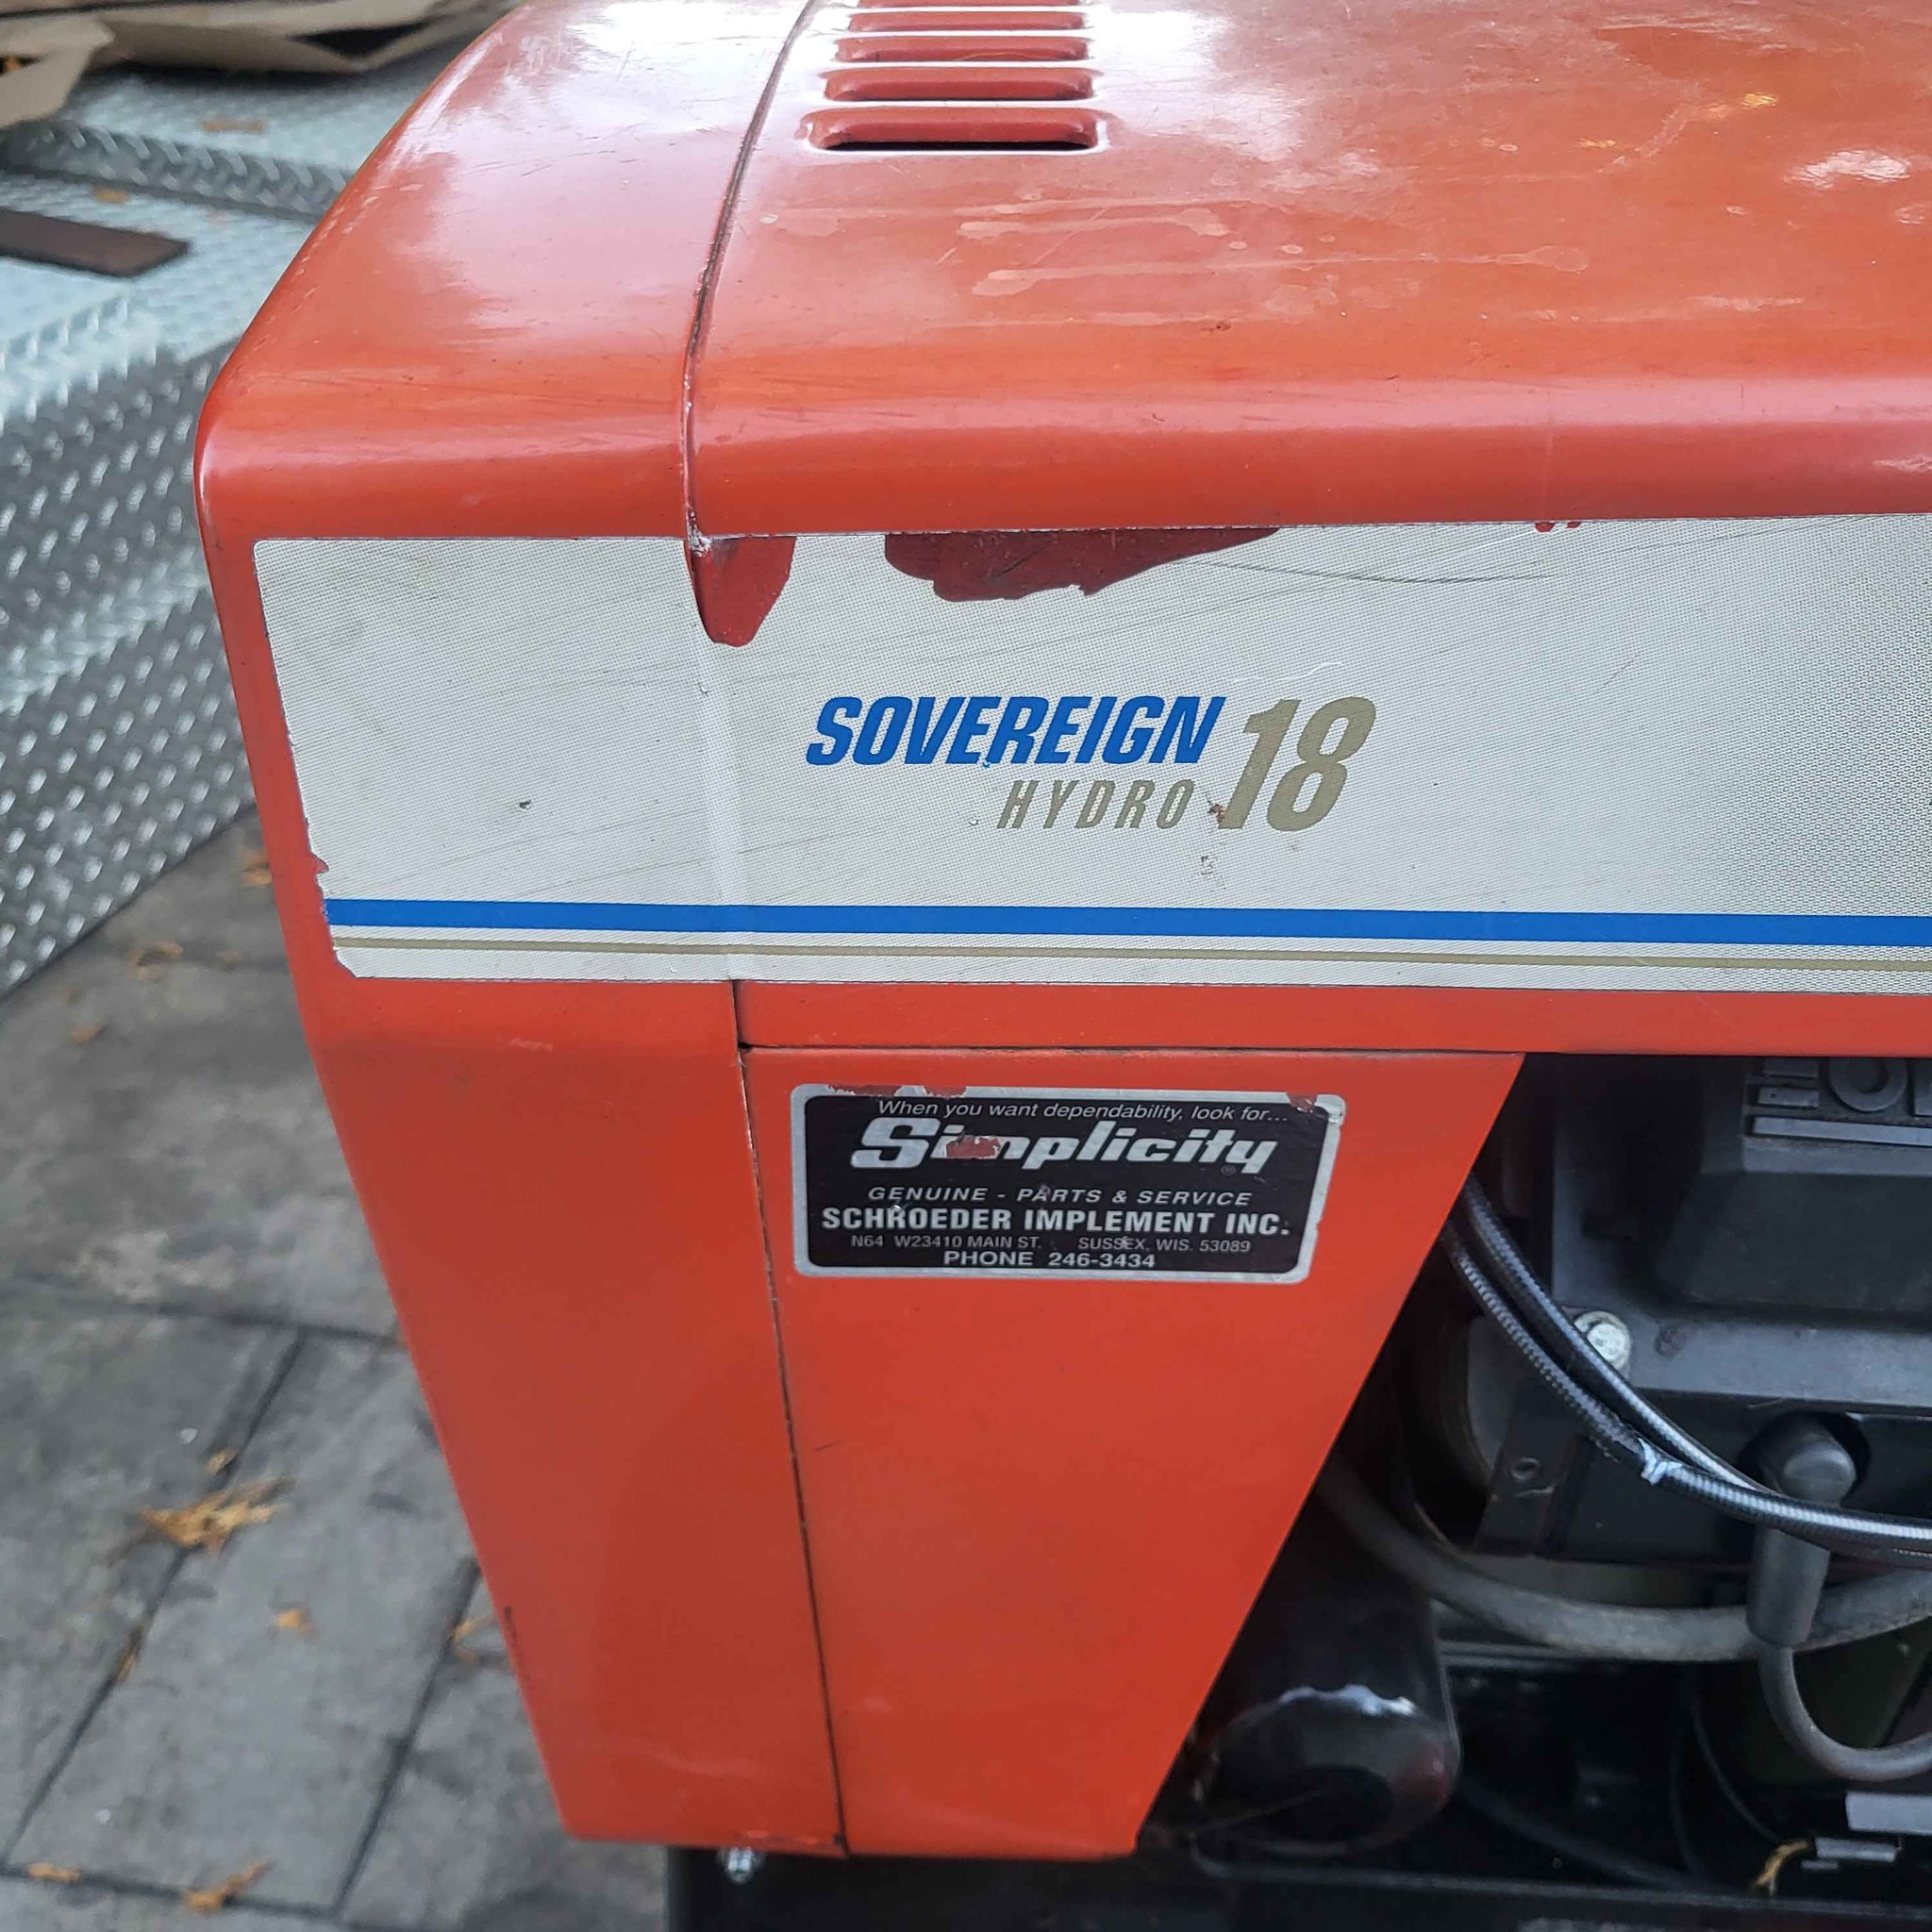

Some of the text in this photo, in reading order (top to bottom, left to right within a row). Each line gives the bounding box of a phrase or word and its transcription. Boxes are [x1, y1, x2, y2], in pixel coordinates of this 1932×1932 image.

[807, 695, 1225, 766] SOVEREIGN
[1218, 696, 1377, 832] 18
[996, 779, 1196, 830] HYDRO
[878, 1100, 1289, 1122] When you want dependability, look for...
[868, 1186, 989, 1202] GENUINE
[1016, 1187, 1103, 1204] PARTS
[1111, 1189, 1128, 1204] &
[1136, 1190, 1253, 1207] SERVICE
[822, 1206, 1291, 1237] SCHROEDER IMPLEMENT INC.
[851, 1235, 884, 1248] N64
[894, 1235, 962, 1249] W23410
[967, 1236, 1013, 1249] MAIN
[1199, 1240, 1252, 1253] 53089
[943, 1250, 1157, 1269] PHONE 246-3434
